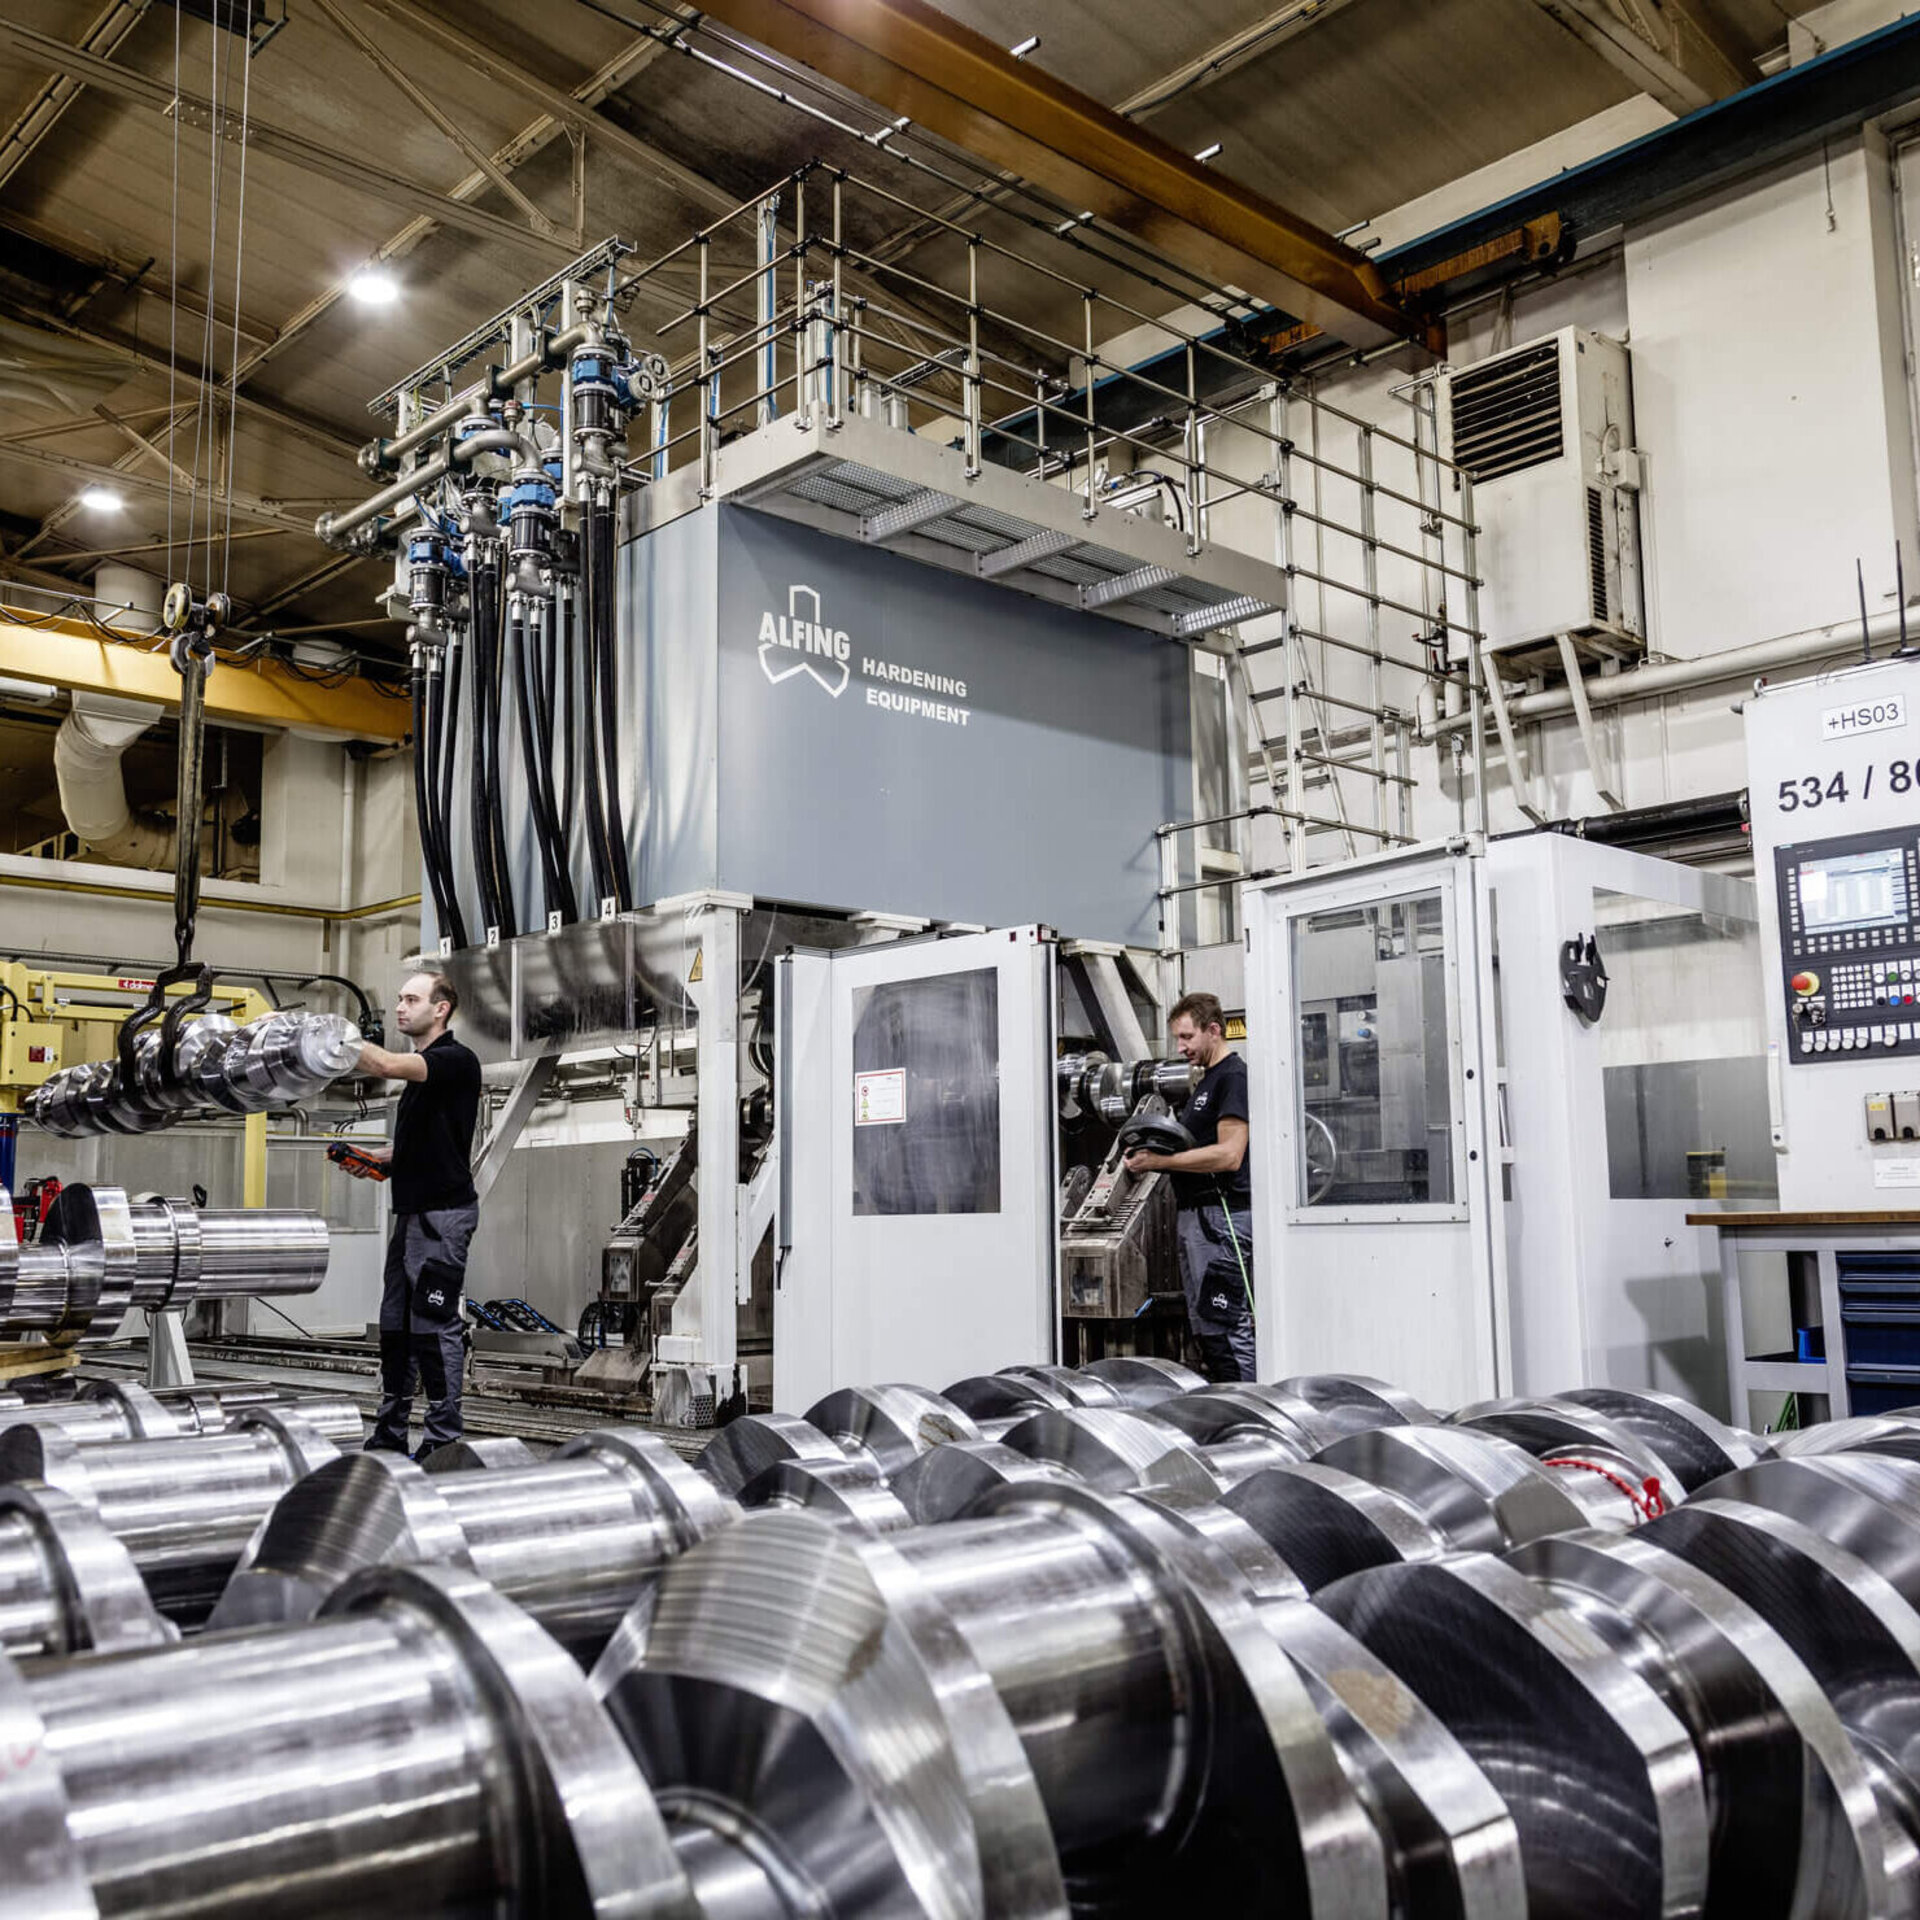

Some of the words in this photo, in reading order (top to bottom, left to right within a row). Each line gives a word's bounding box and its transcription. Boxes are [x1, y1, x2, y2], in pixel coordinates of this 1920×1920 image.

[758, 611, 851, 661] ALFING
[862, 657, 967, 697] HARDENING
[865, 687, 971, 727] EQUIPMENT
[1828, 703, 1899, 729] +HS03
[1778, 771, 1849, 812] 534
[1863, 765, 1874, 800] /
[1889, 758, 1920, 794] 8
[551, 915, 559, 930] 3
[604, 902, 612, 917] 4
[490, 931, 497, 945] 2
